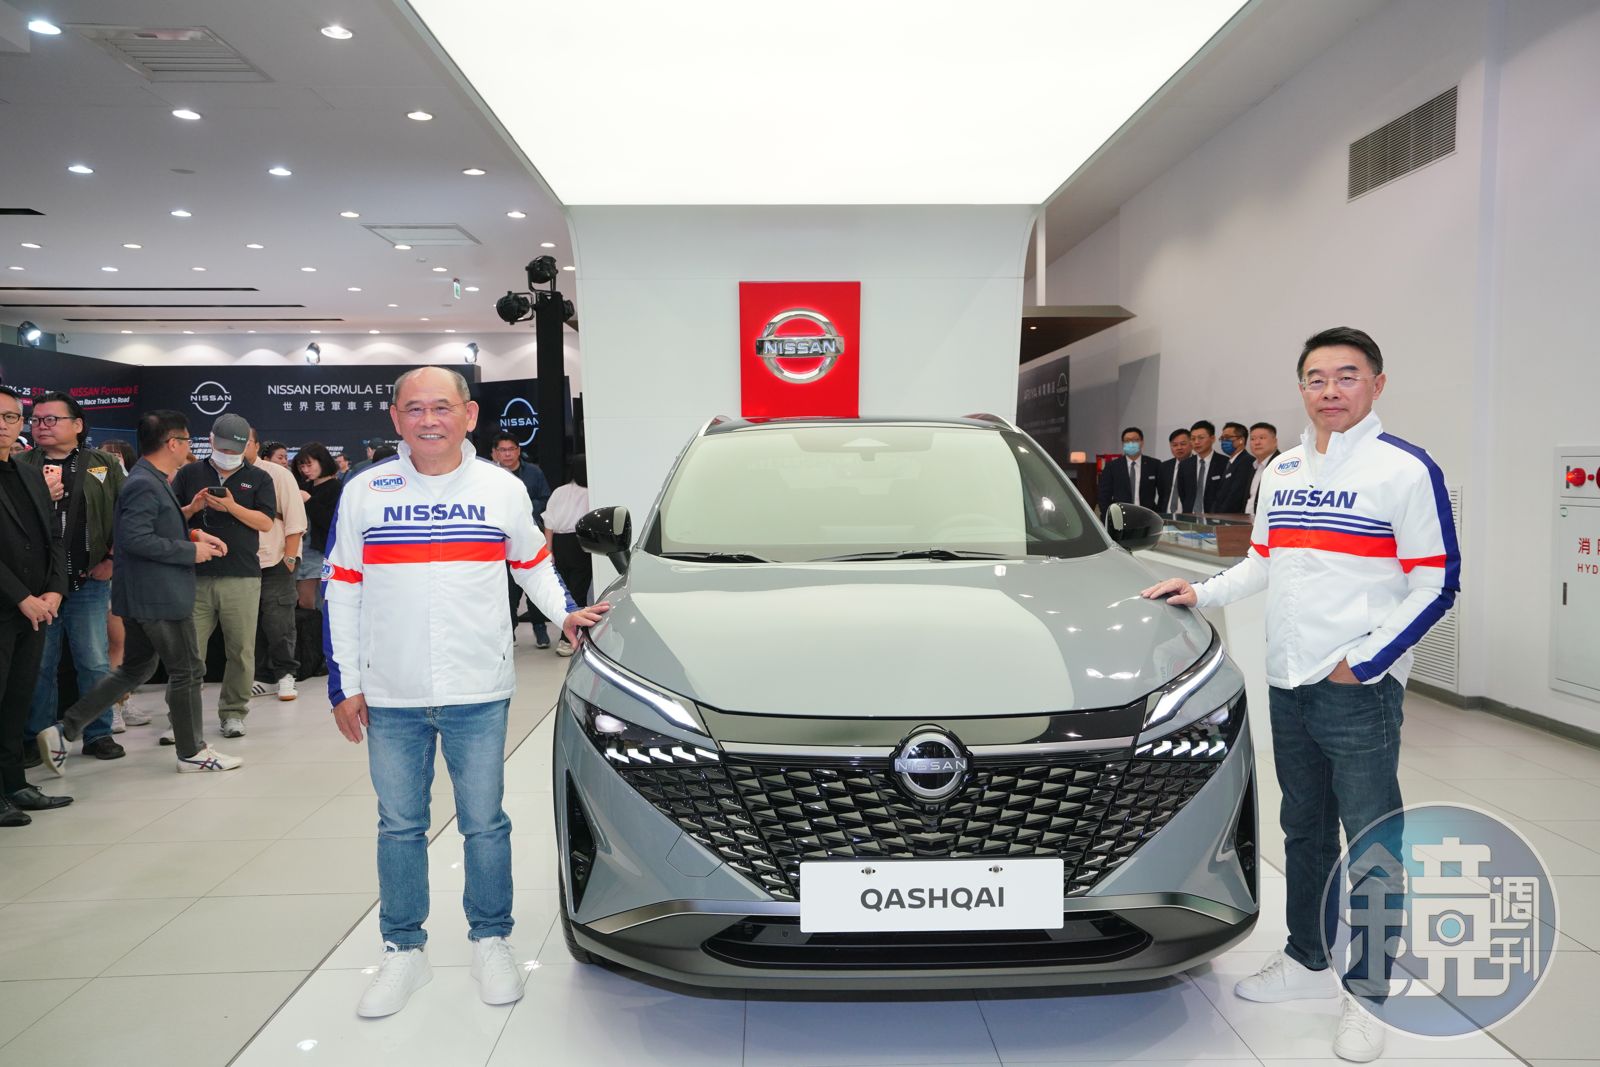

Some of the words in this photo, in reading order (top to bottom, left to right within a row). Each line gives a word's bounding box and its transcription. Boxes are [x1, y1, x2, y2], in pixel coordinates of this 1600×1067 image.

[764, 340, 836, 354] NISSAN
[70, 387, 99, 397] NISSAN
[101, 386, 132, 396] Formula
[133, 385, 139, 394] E
[267, 384, 311, 395] NISSAN
[314, 384, 374, 395] FORMULA
[375, 384, 383, 394] E
[385, 384, 393, 394] T
[190, 394, 232, 402] NISSAN
[500, 417, 539, 427] NISSAN
[1277, 460, 1300, 470] NISMO
[373, 477, 403, 486] NISMO
[1272, 489, 1358, 509] NISSAN
[383, 503, 486, 523] NISSAN
[1578, 537, 1600, 555] 消
[896, 758, 967, 772] NISSAN
[860, 886, 1005, 912] QASHQAI
